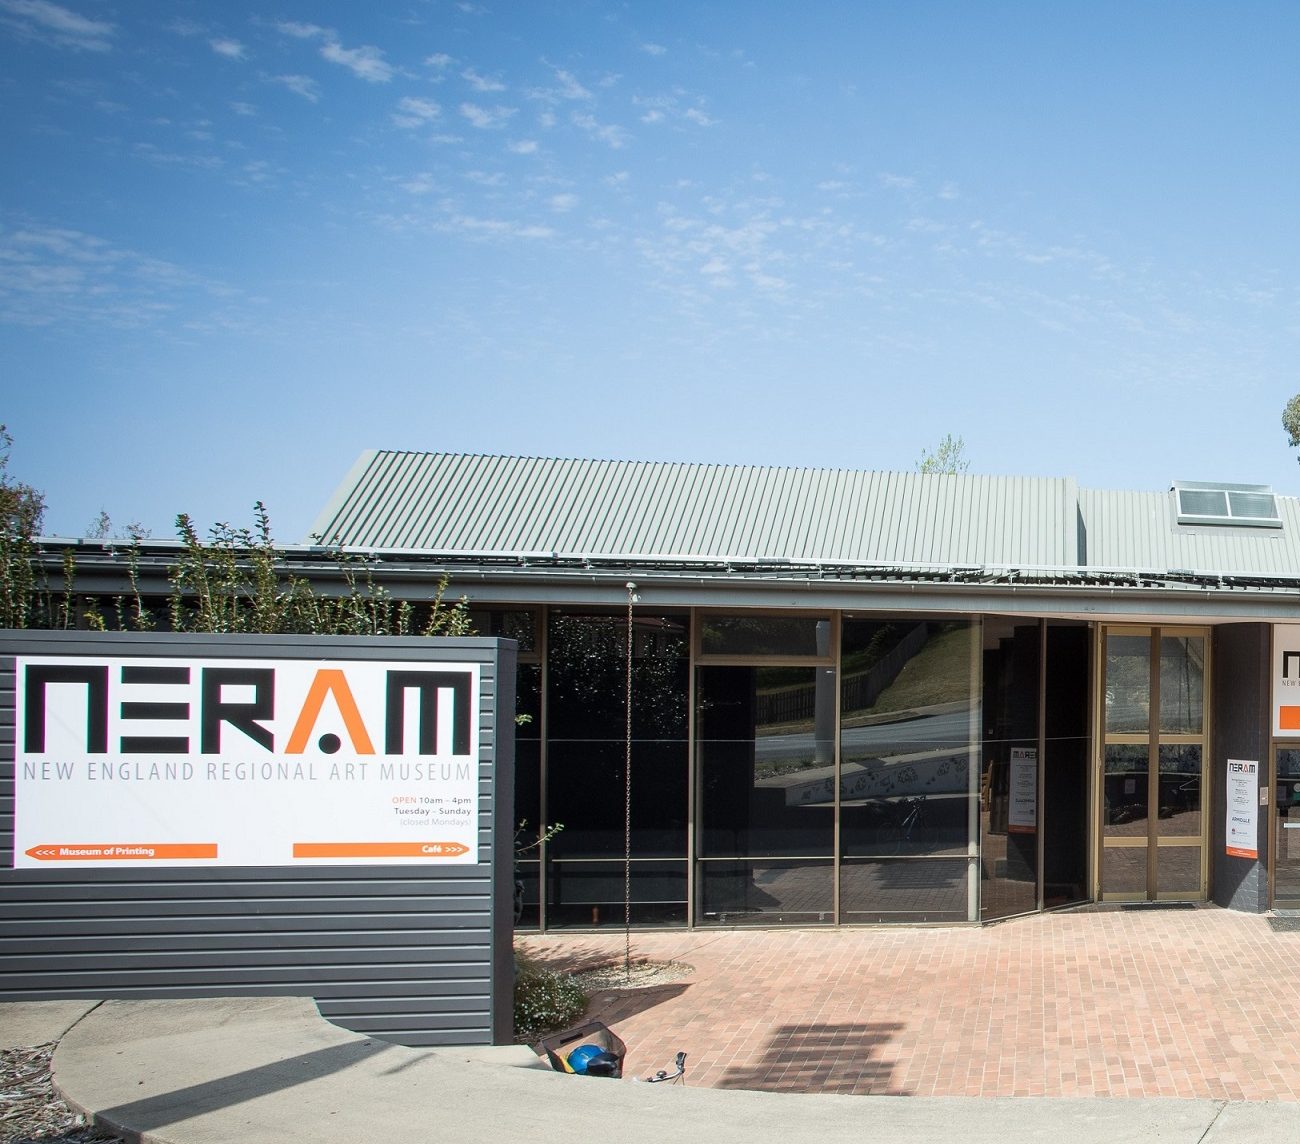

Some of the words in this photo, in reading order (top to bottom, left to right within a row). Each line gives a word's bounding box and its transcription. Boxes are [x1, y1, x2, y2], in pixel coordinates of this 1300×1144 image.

[24, 664, 472, 755] NERAM
[24, 762, 74, 780] NEW
[88, 762, 194, 780] ENGLAND
[207, 762, 318, 781] REGIONAL
[330, 763, 369, 781] ART
[380, 763, 471, 781] MUSEUM
[1229, 763, 1256, 773] NERAM
[452, 797, 472, 805] 4pm
[394, 808, 431, 816] Tuesday
[439, 808, 472, 816] Sunday
[400, 818, 430, 826] (closed
[431, 818, 472, 827] Mondays)
[59, 848, 102, 856] Museum
[103, 847, 114, 856] of
[115, 847, 155, 857] Printing
[422, 845, 442, 853] Café
